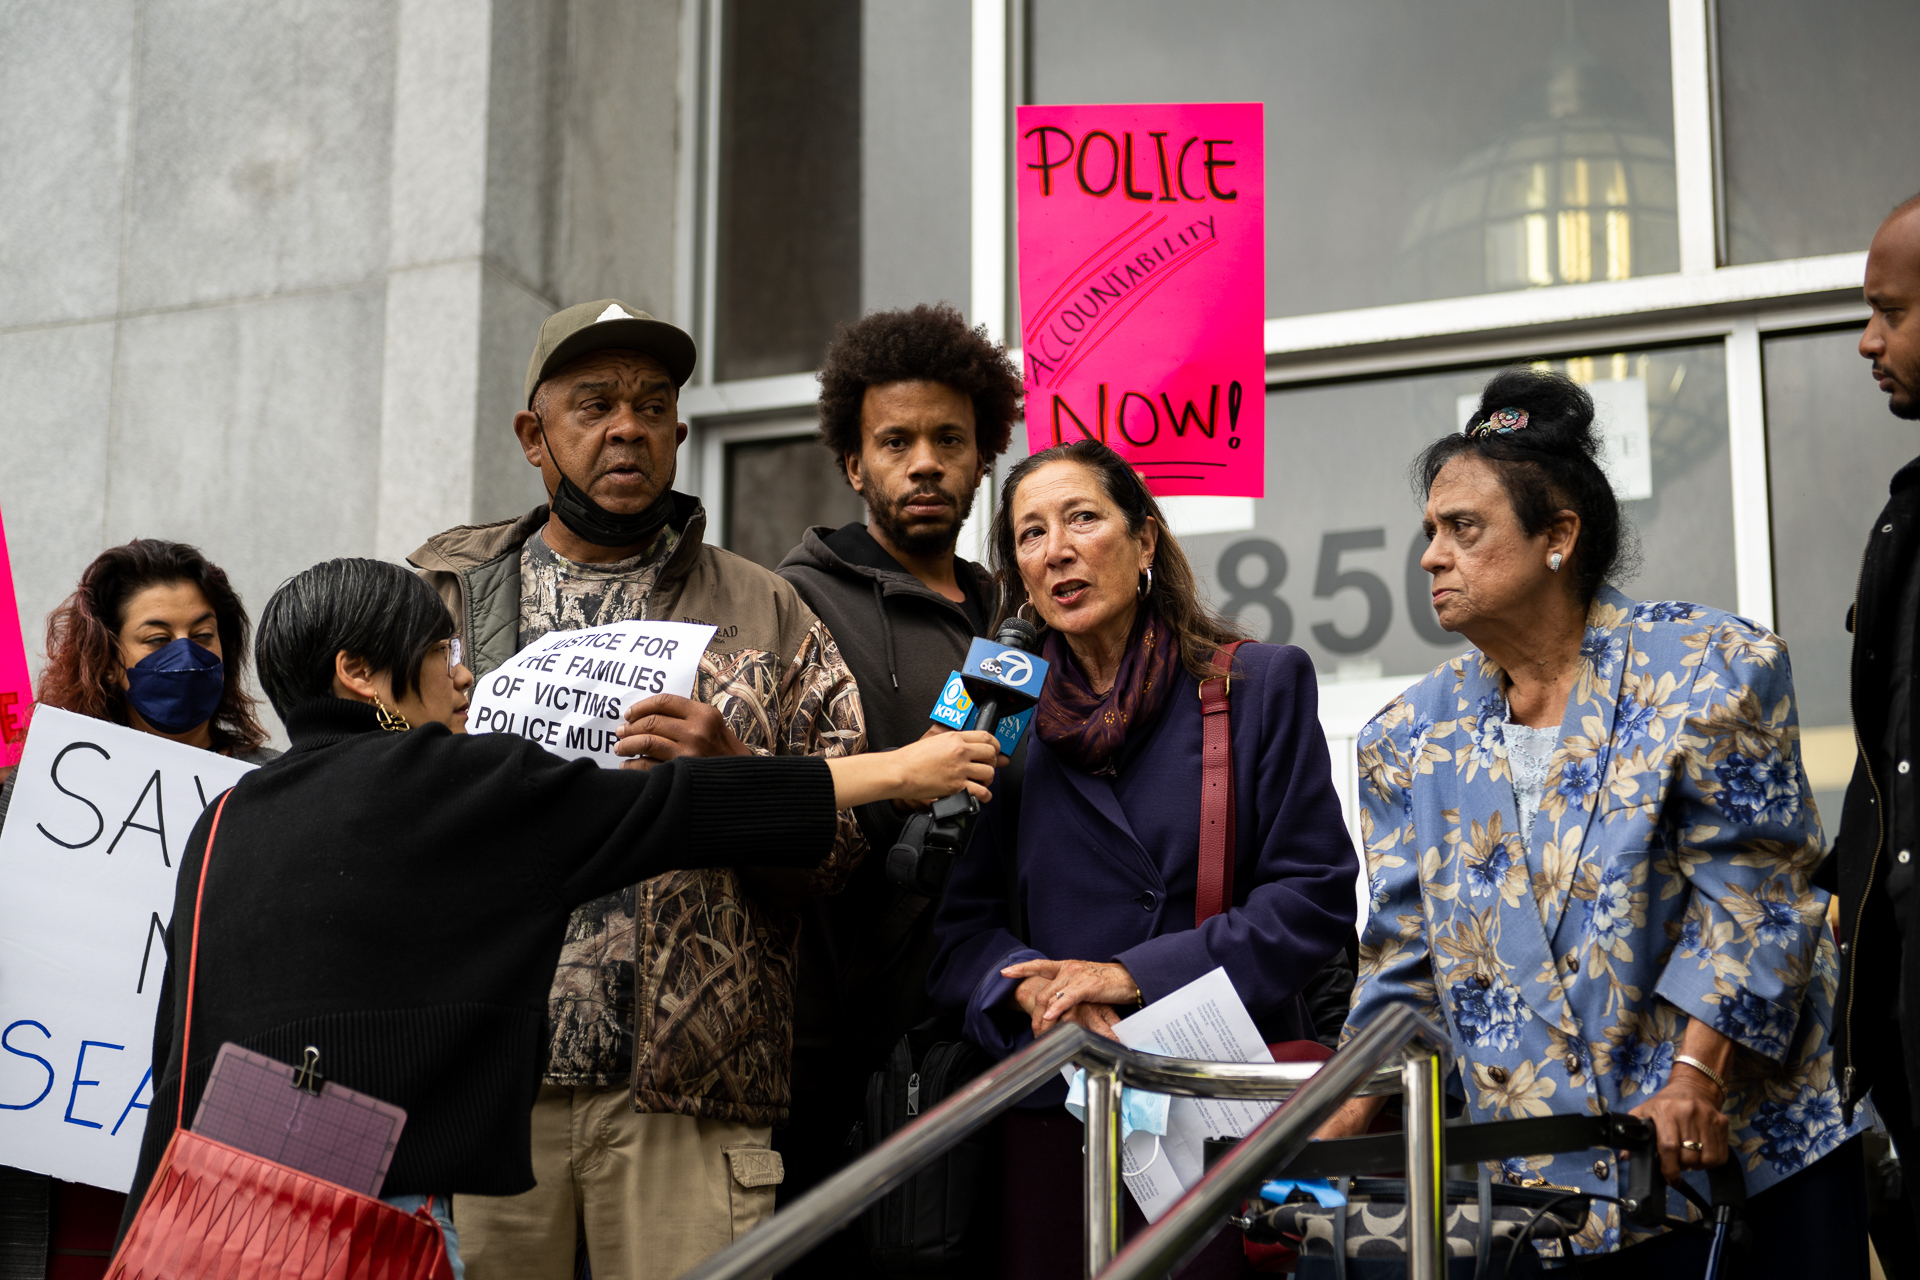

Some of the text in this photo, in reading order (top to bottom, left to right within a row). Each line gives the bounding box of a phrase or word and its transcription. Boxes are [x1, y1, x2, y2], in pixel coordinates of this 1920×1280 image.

[1023, 125, 1237, 202] POLICE
[1028, 215, 1217, 385] ACCOUNTABILITY
[1050, 380, 1242, 450] NOW!
[1216, 528, 1472, 655] 850
[542, 632, 679, 660] JUSTICE FOR
[518, 653, 667, 694] THE FAMILIES
[979, 661, 1003, 676] abc
[492, 675, 622, 720] OF VICTIMS
[934, 704, 966, 725] KPIX
[475, 706, 562, 746] POLICE
